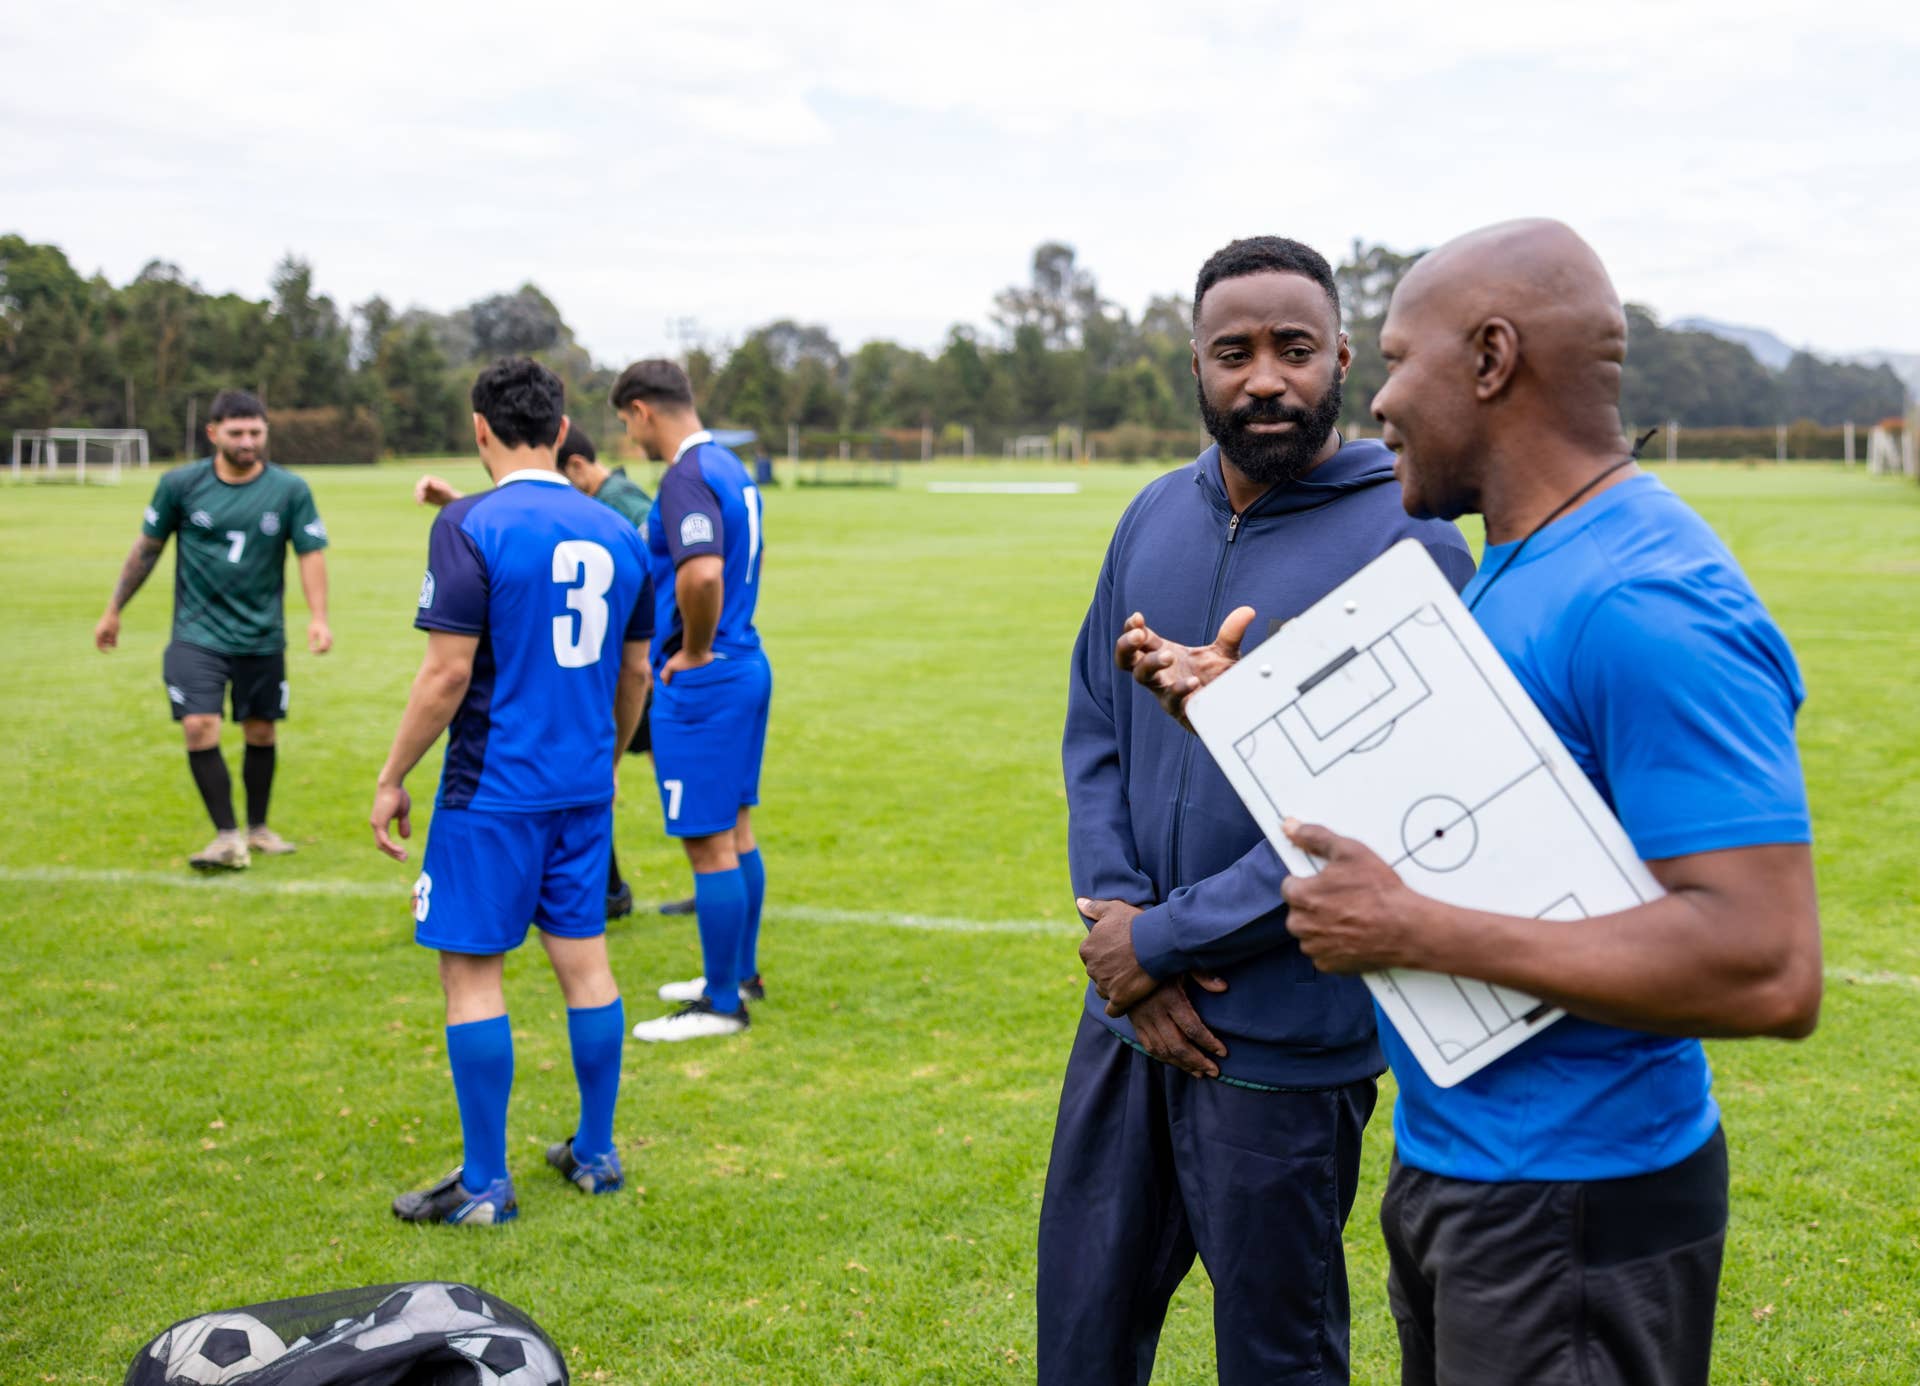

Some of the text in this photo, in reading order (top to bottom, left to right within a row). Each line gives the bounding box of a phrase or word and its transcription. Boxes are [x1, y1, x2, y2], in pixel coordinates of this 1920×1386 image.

[226, 531, 246, 563] 7
[552, 540, 614, 668] 3
[663, 779, 683, 820] 7
